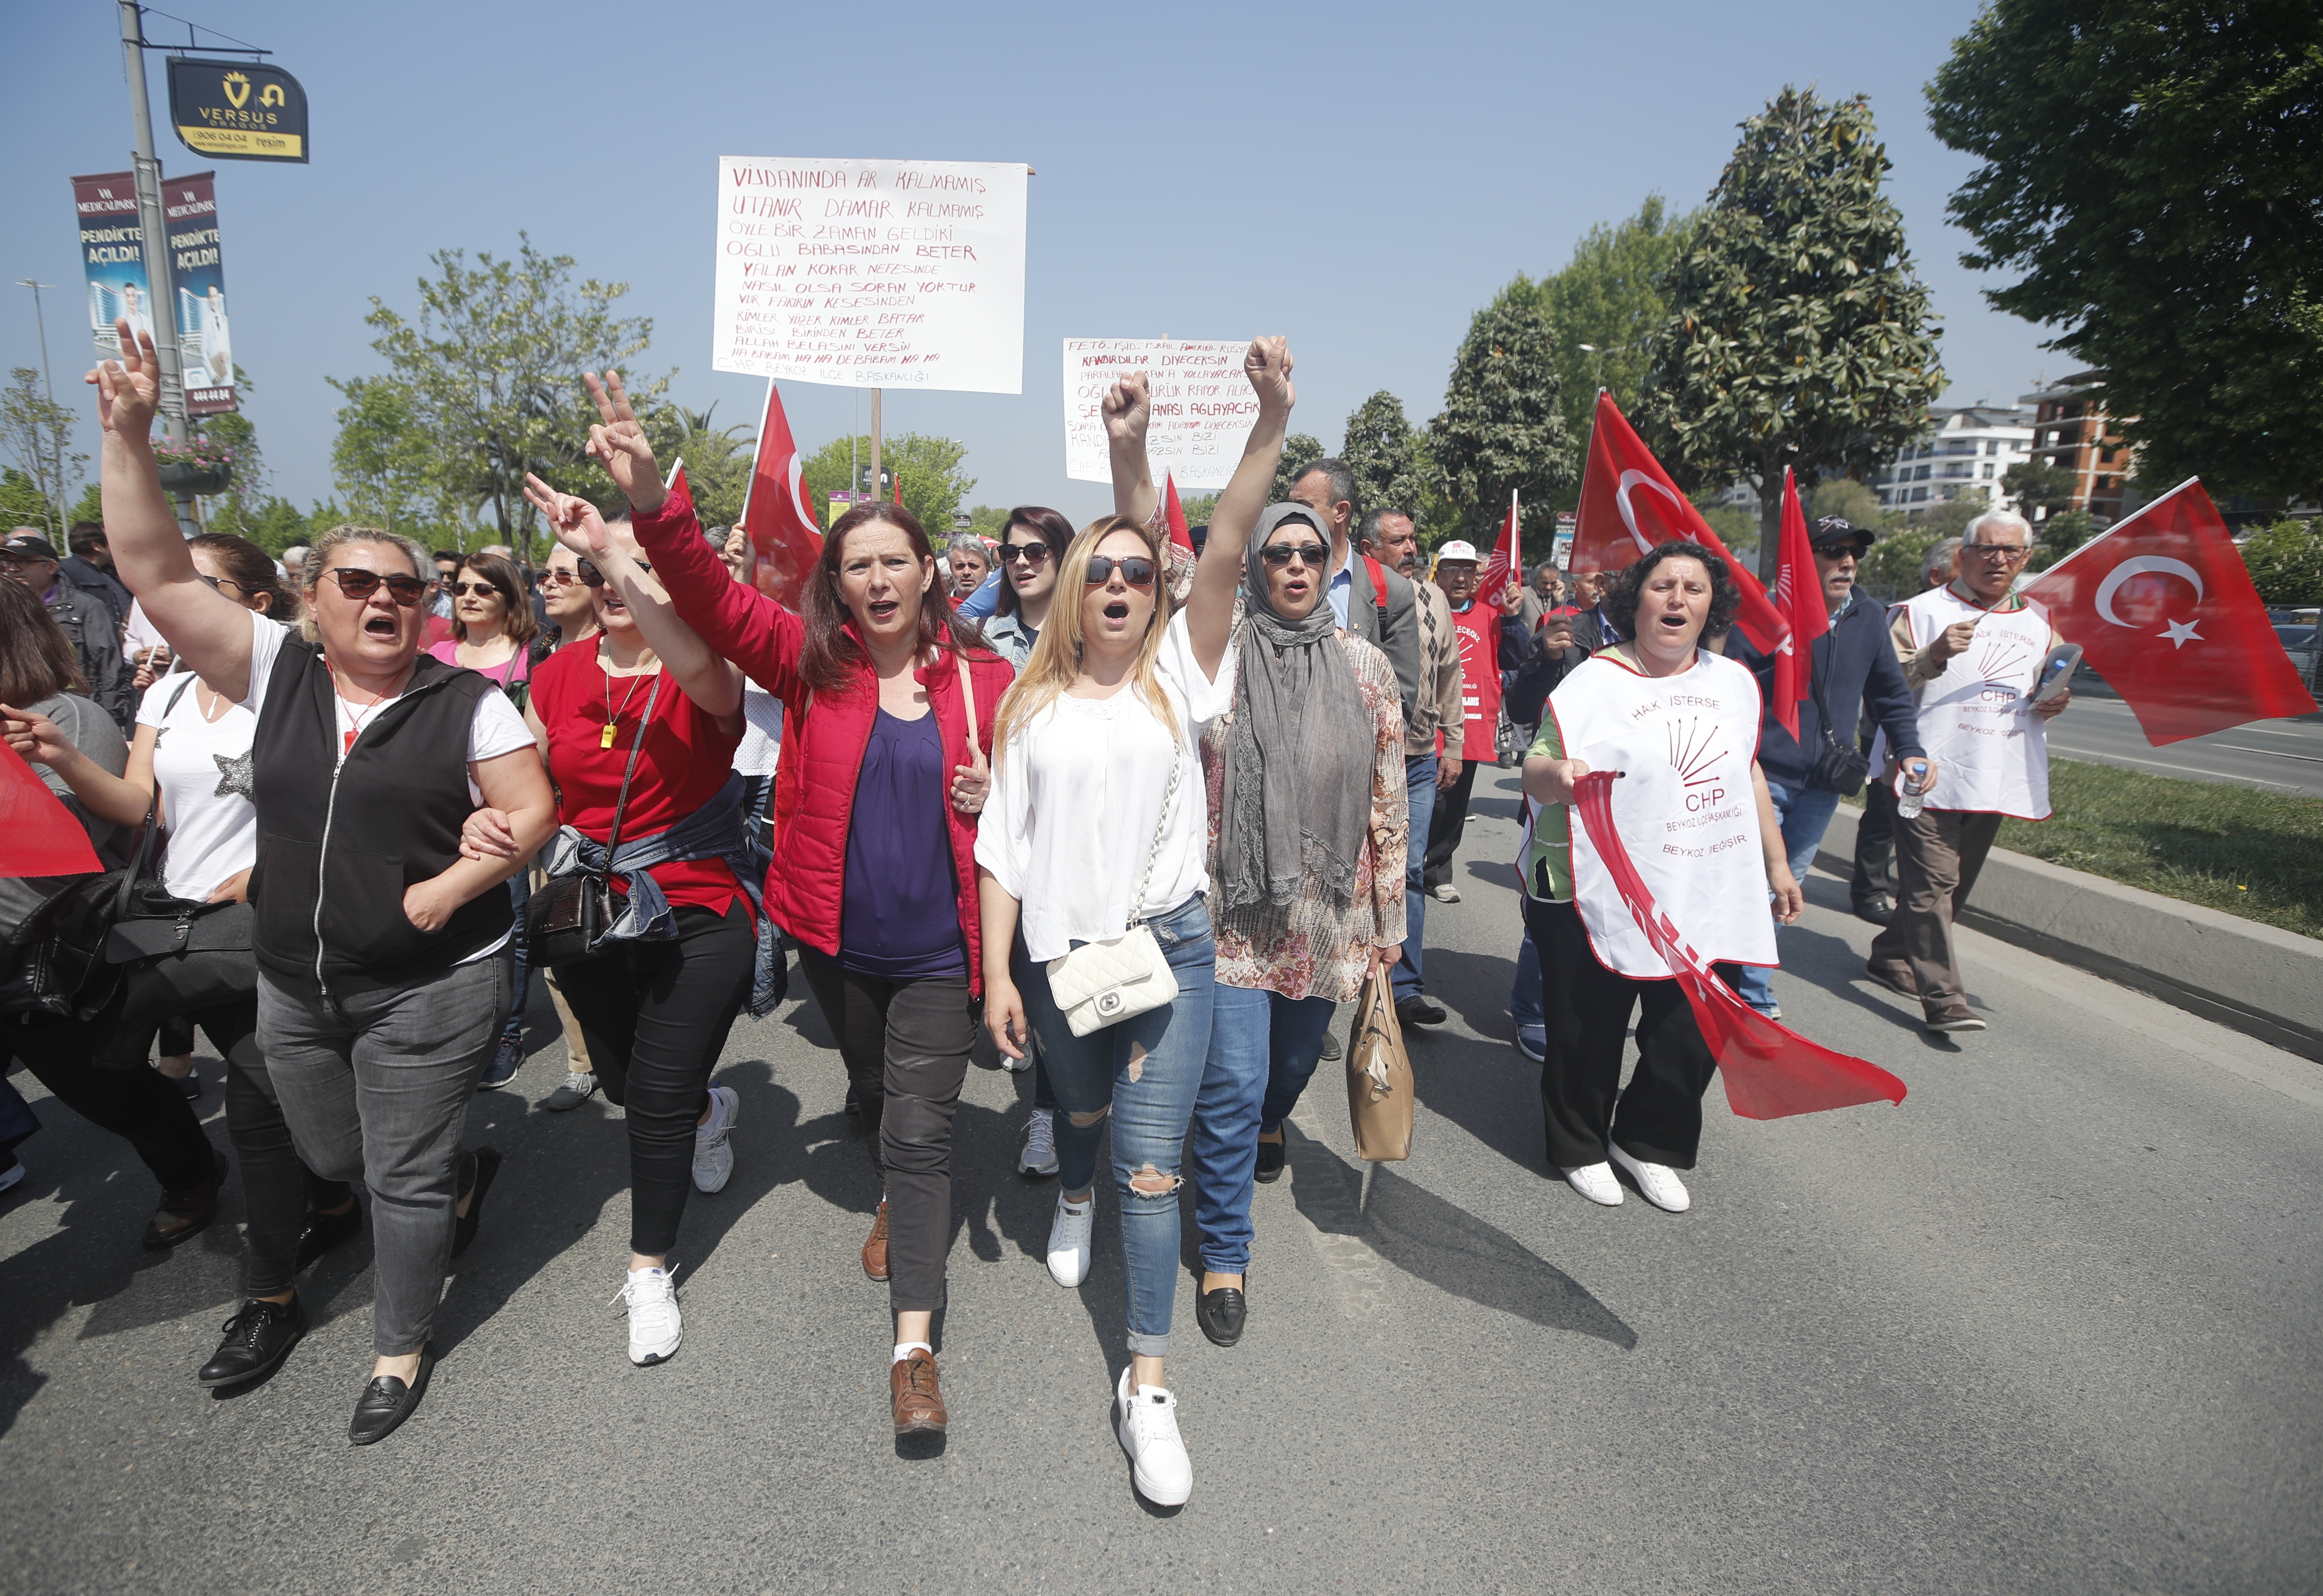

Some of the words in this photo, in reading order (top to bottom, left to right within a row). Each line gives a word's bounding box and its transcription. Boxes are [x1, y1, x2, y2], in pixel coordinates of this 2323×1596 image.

[199, 106, 277, 125] VERSUS
[209, 119, 268, 131] DRAGOS
[857, 170, 877, 190] AR
[895, 171, 986, 195] KALMAMIŞ
[733, 195, 802, 221] UTANIR
[825, 198, 895, 219] DAMAR
[906, 201, 983, 219] KALMAMIŞ
[80, 225, 143, 243] PENDİK'TE
[170, 228, 220, 249] PENDİK'TE
[729, 220, 768, 235] ÖYLE
[774, 221, 806, 239] BİR
[813, 225, 876, 241] ZAMAN
[887, 224, 953, 242] GELDİKİ
[89, 246, 140, 267] AÇILDI!
[727, 238, 780, 257] OĞLU
[799, 243, 900, 256] BABASINDAN
[916, 245, 979, 263] BETER
[177, 247, 219, 272] AÇILDI!
[744, 262, 796, 276] YALAN
[807, 263, 859, 276] KOKAR
[868, 261, 941, 275] NEFESİNDE
[742, 280, 787, 292] NASIL
[795, 283, 841, 293] OLSA
[848, 282, 906, 293] SORAN
[916, 281, 976, 293] YOKTUR
[769, 295, 814, 309] FAKİRİN
[824, 294, 915, 309] KESESİNDEN
[737, 309, 781, 323] KİMLER
[830, 313, 869, 326] KİMLER
[878, 313, 925, 324] BATAR
[856, 328, 904, 339] BETER
[735, 336, 779, 348] ALLAH
[787, 340, 855, 352] BELASINI
[864, 341, 910, 352] VERSİN
[731, 348, 747, 357] HA
[751, 350, 790, 361] BABAM
[795, 354, 812, 363] HA
[813, 354, 832, 363] HA
[901, 354, 919, 365] HA
[1082, 355, 1151, 367] KANDIRDILAR
[1162, 353, 1228, 366] DİYECEKSİN
[717, 357, 755, 371] CHP
[766, 361, 808, 376] BEYKOZ
[1150, 382, 1182, 398] ÜRÜK
[1188, 384, 1222, 396] RAPOR
[1152, 403, 1183, 416] ANASI
[1191, 402, 1260, 416] AĞLAYACAK
[1068, 420, 1096, 431] SONRA
[1204, 417, 1254, 430] DİYECEKSİN
[1191, 431, 1217, 441] BİZİ
[1192, 443, 1219, 455] BİZİ
[1069, 459, 1093, 473] CHP
[1179, 463, 1239, 479] BAŞKANLIĞ
[1981, 689, 2017, 703] CHP
[1631, 700, 1661, 721] HALK
[1670, 695, 1720, 710] İSTERSE
[1958, 722, 1995, 735] BEYKOZ
[1686, 789, 1725, 811] CHP
[1667, 818, 1696, 832] BEYKOZ
[1663, 844, 1704, 857] BEYKOZ
